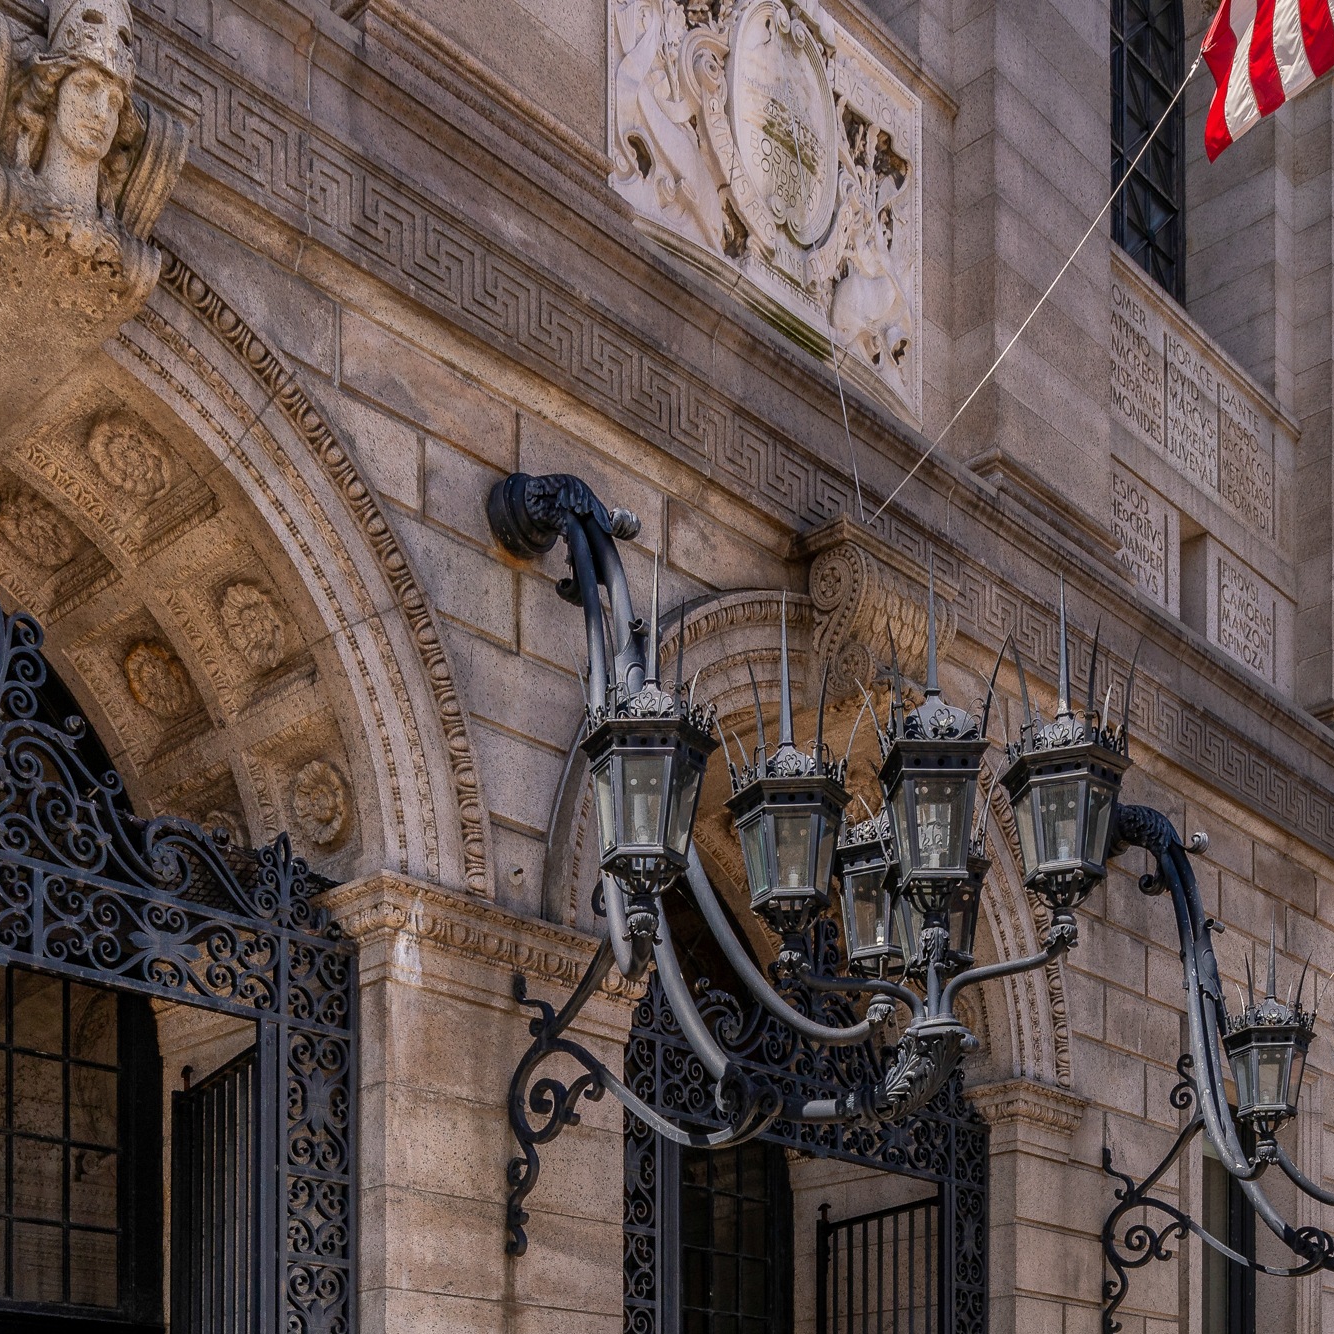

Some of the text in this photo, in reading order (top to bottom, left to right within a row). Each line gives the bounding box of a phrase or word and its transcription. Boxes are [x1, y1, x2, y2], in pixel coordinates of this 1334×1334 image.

[773, 181, 797, 208] 1630
[1169, 336, 1213, 392] HORACE
[1169, 362, 1199, 400] OVID
[1221, 382, 1261, 433] DANTE
[1221, 407, 1259, 453] TASSO
[1221, 432, 1271, 487] BOCCACCIO
[1221, 455, 1272, 511] METASTASIO
[1221, 479, 1271, 532] LEOPARDI
[1111, 518, 1164, 576] ENANDER
[1221, 583, 1273, 636] CAMOENS
[1221, 608, 1270, 656] MANZONI
[1221, 628, 1266, 677] SPINOZA
